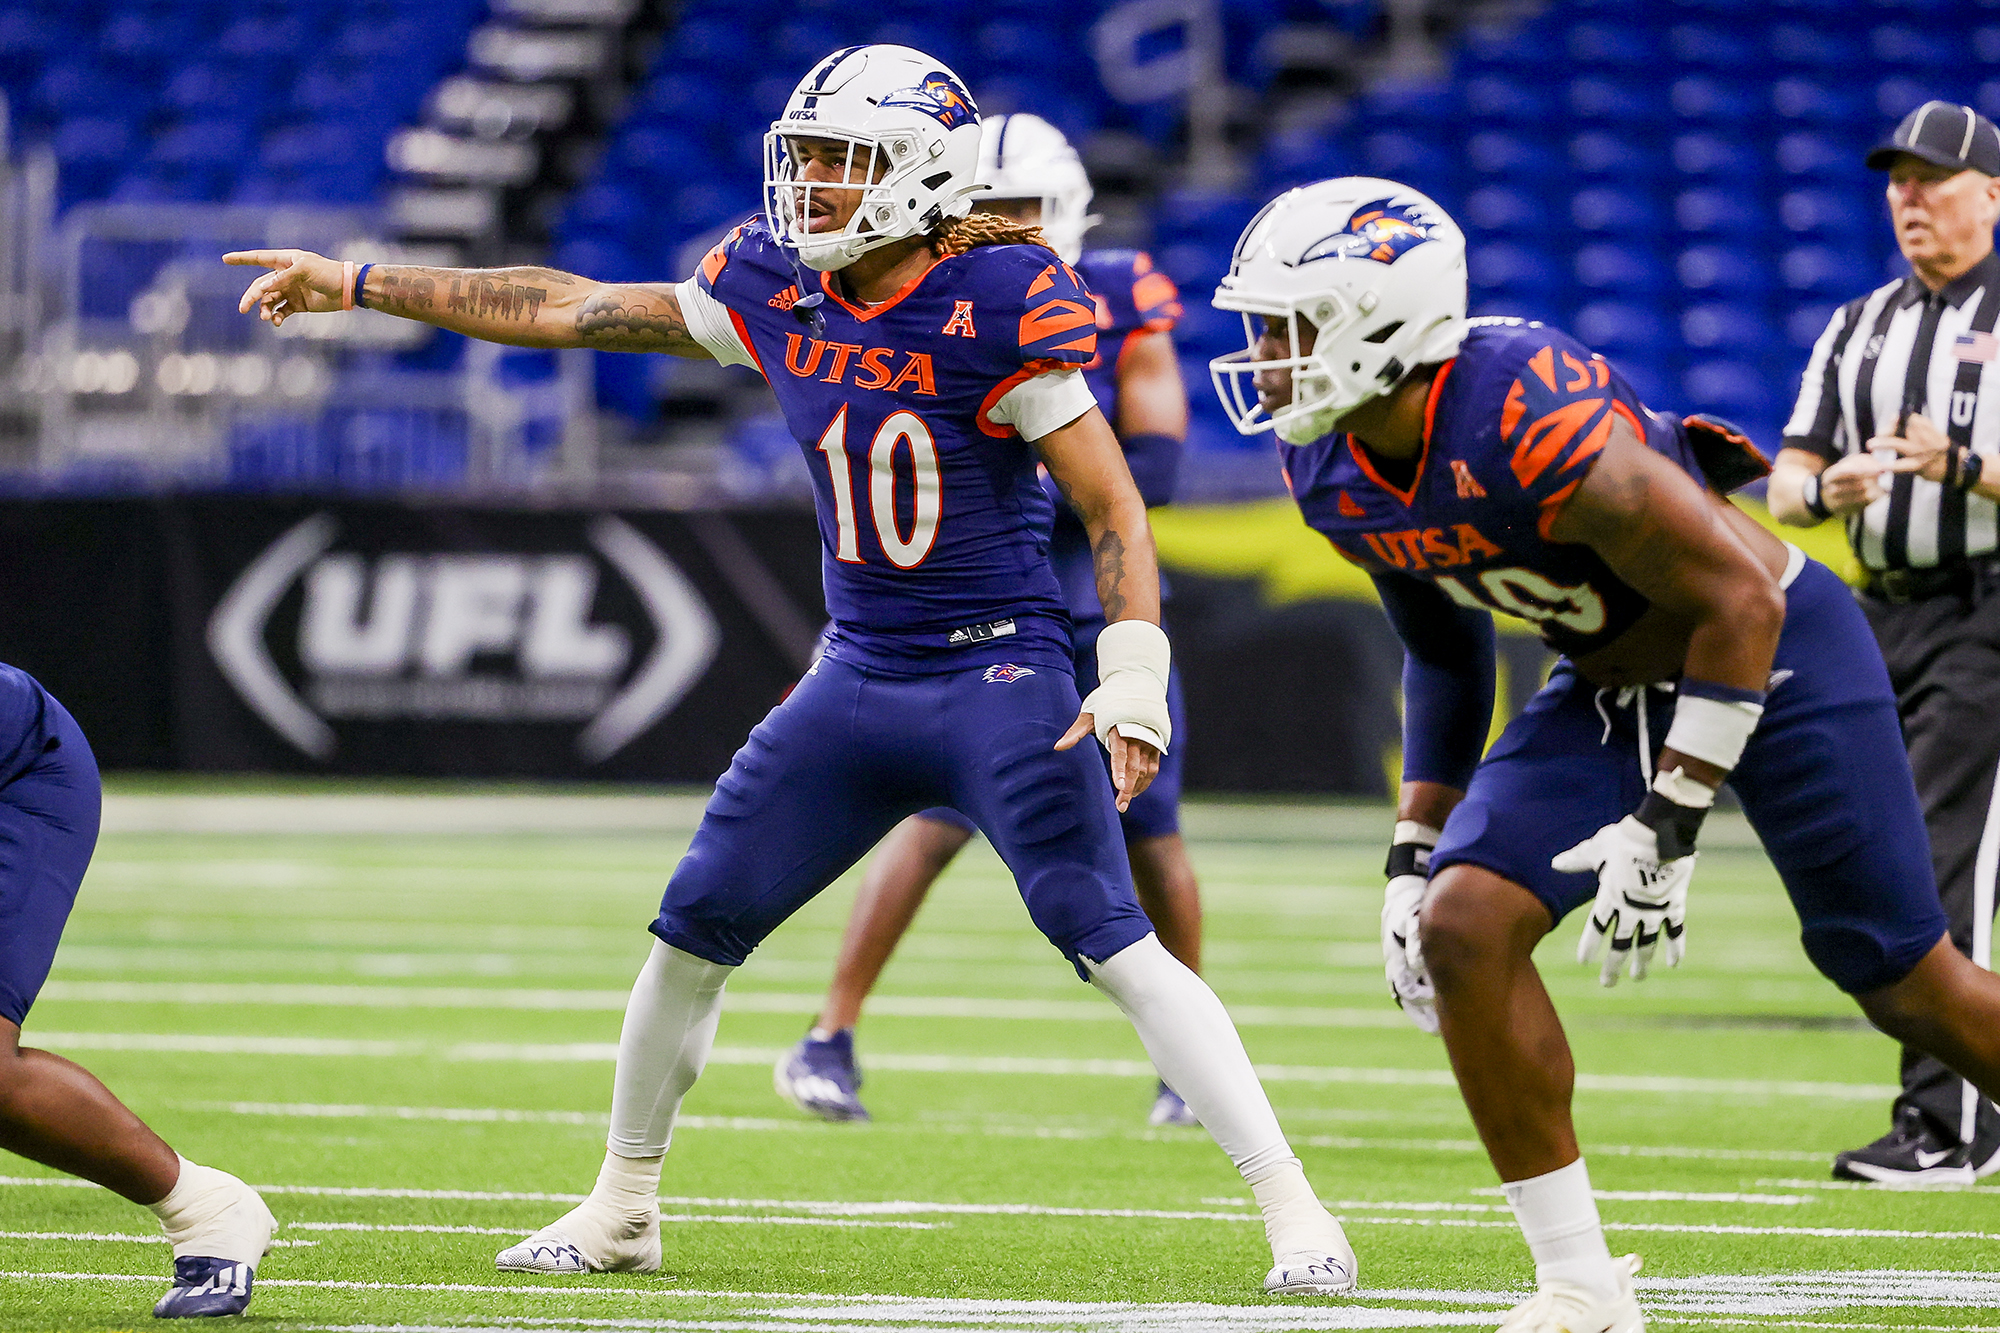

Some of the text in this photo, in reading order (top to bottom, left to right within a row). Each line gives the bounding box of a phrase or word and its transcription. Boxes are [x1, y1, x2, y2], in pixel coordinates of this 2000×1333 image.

[789, 110, 817, 121] UTSA
[447, 278, 547, 323] LIMIT
[784, 331, 938, 397] UTSA
[1951, 391, 1976, 427] U
[815, 401, 943, 570] 10
[1361, 523, 1501, 570] UTSA
[302, 552, 632, 677] UFL
